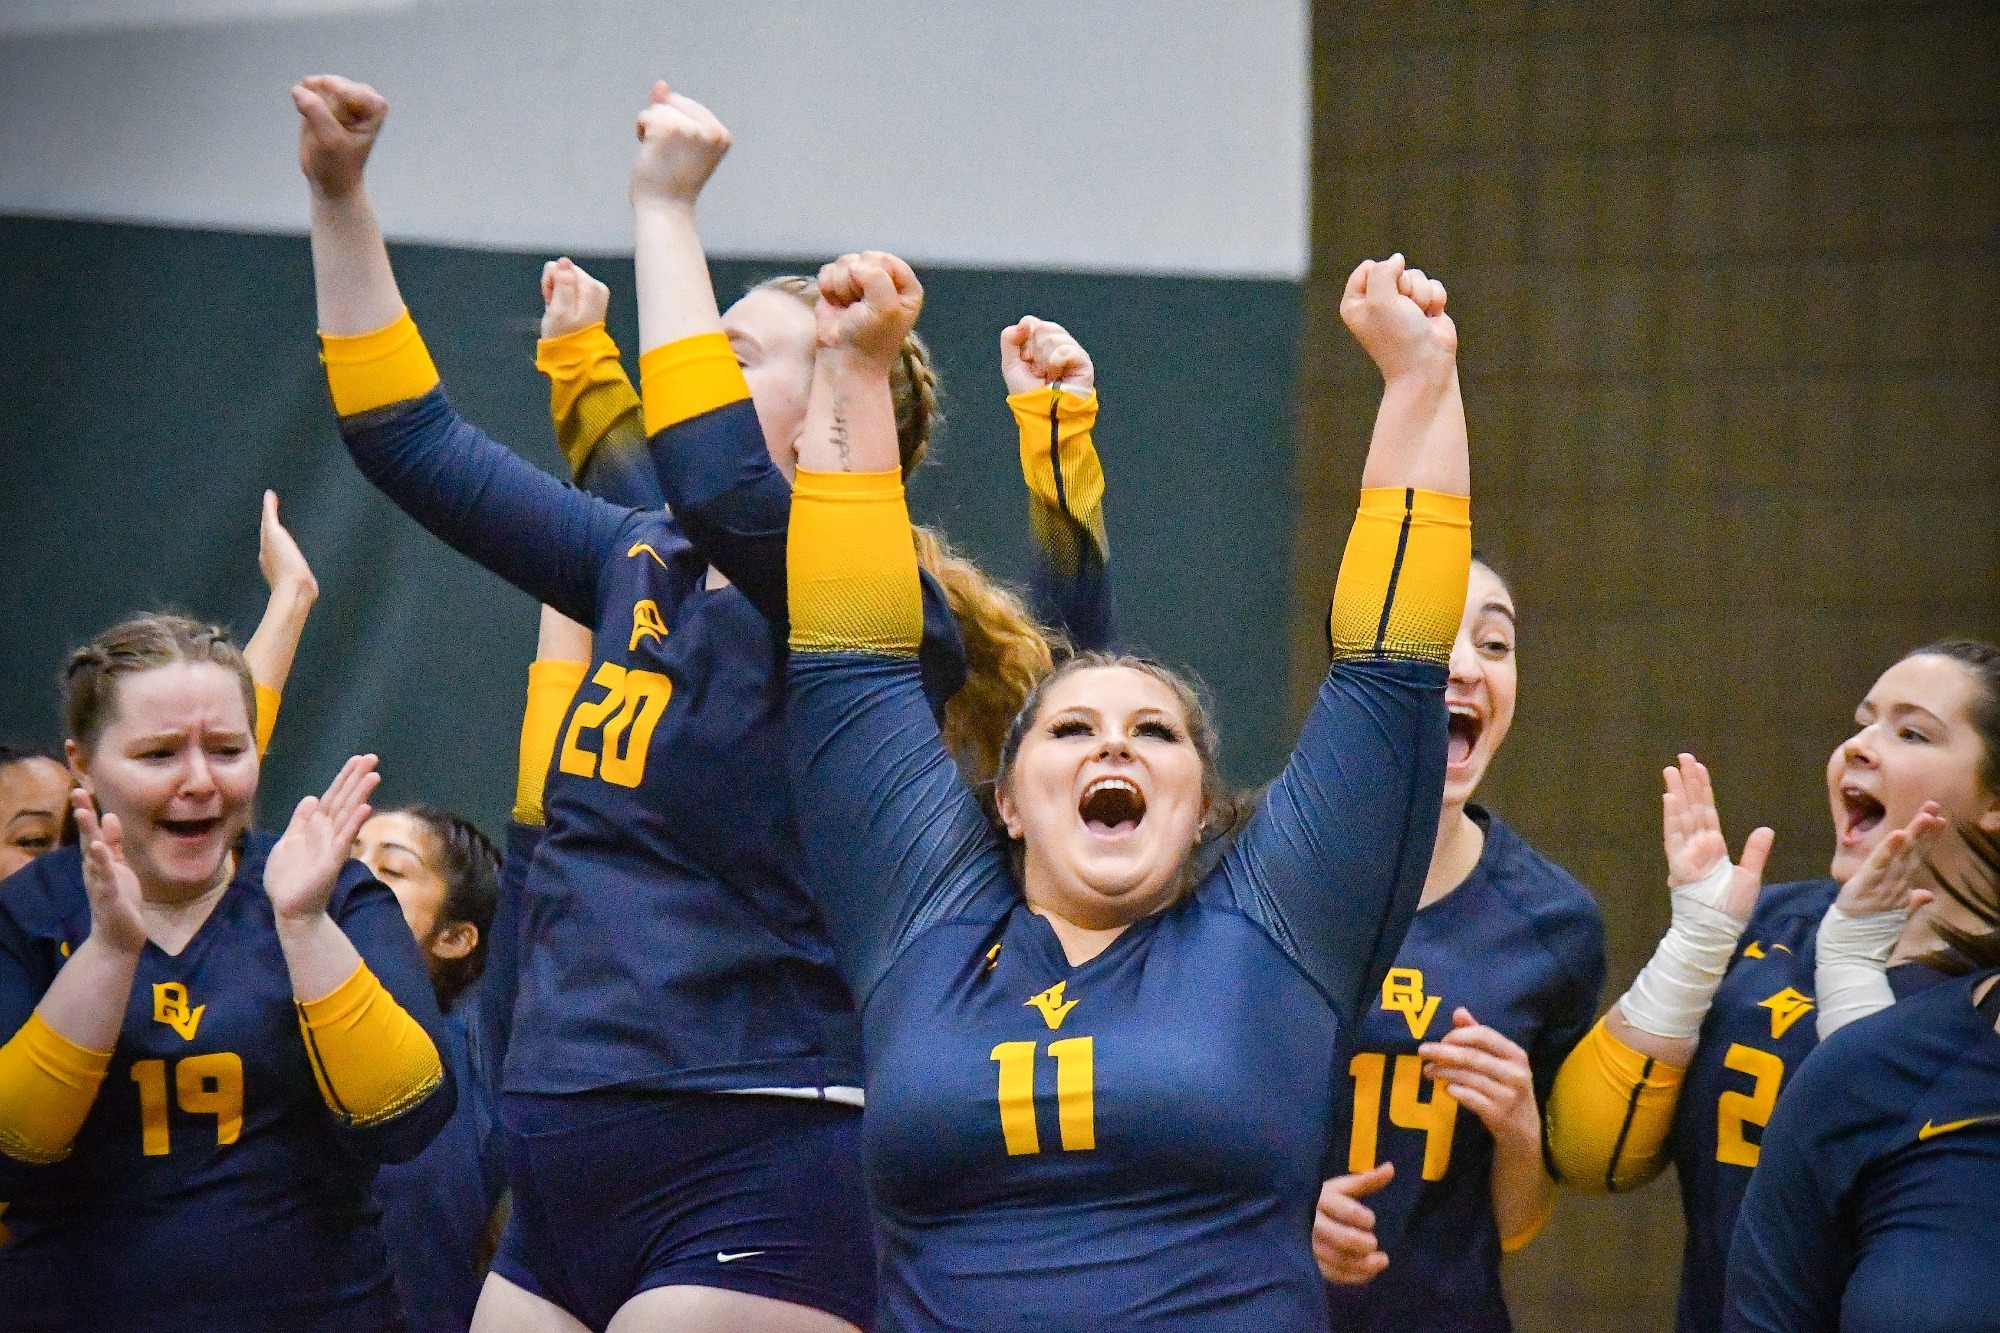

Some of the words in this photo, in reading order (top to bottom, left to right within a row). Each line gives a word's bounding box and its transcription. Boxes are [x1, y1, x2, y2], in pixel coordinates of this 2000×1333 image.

[559, 661, 673, 788] 20
[152, 981, 207, 1041] BV
[1381, 967, 1442, 1040] BV
[130, 1052, 244, 1157] 19
[990, 1036, 1096, 1156] 11
[1349, 1053, 1459, 1182] 14
